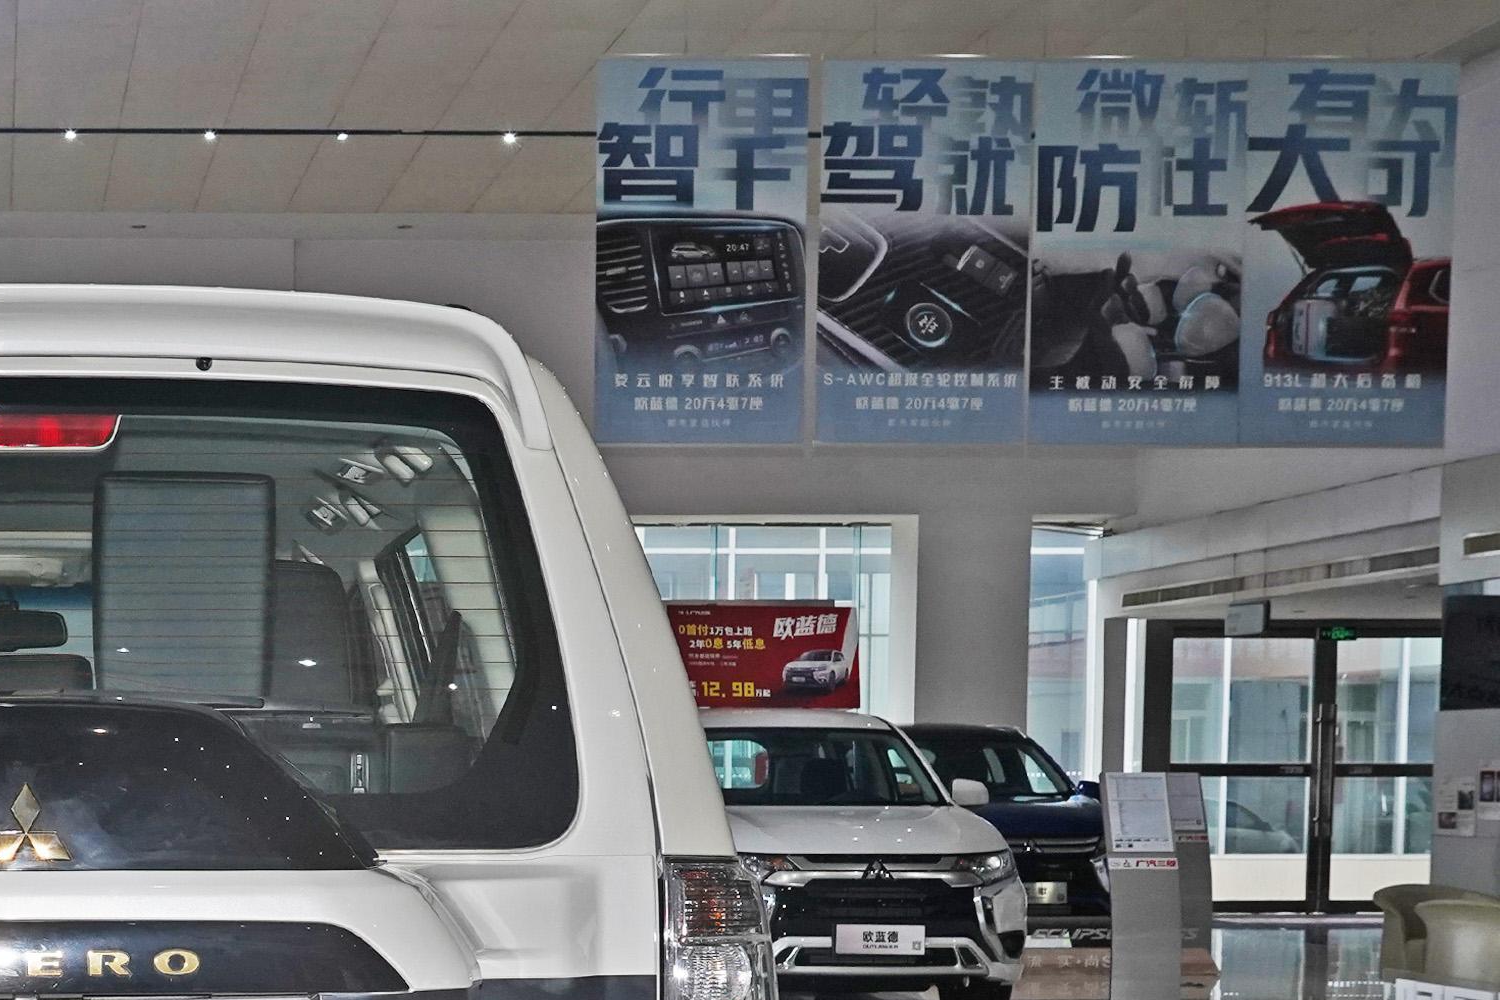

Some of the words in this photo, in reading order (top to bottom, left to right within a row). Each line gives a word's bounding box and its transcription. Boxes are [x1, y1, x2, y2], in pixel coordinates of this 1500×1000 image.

[773, 613, 838, 640] 欧蓝德
[862, 931, 899, 943] 欧蓝德
